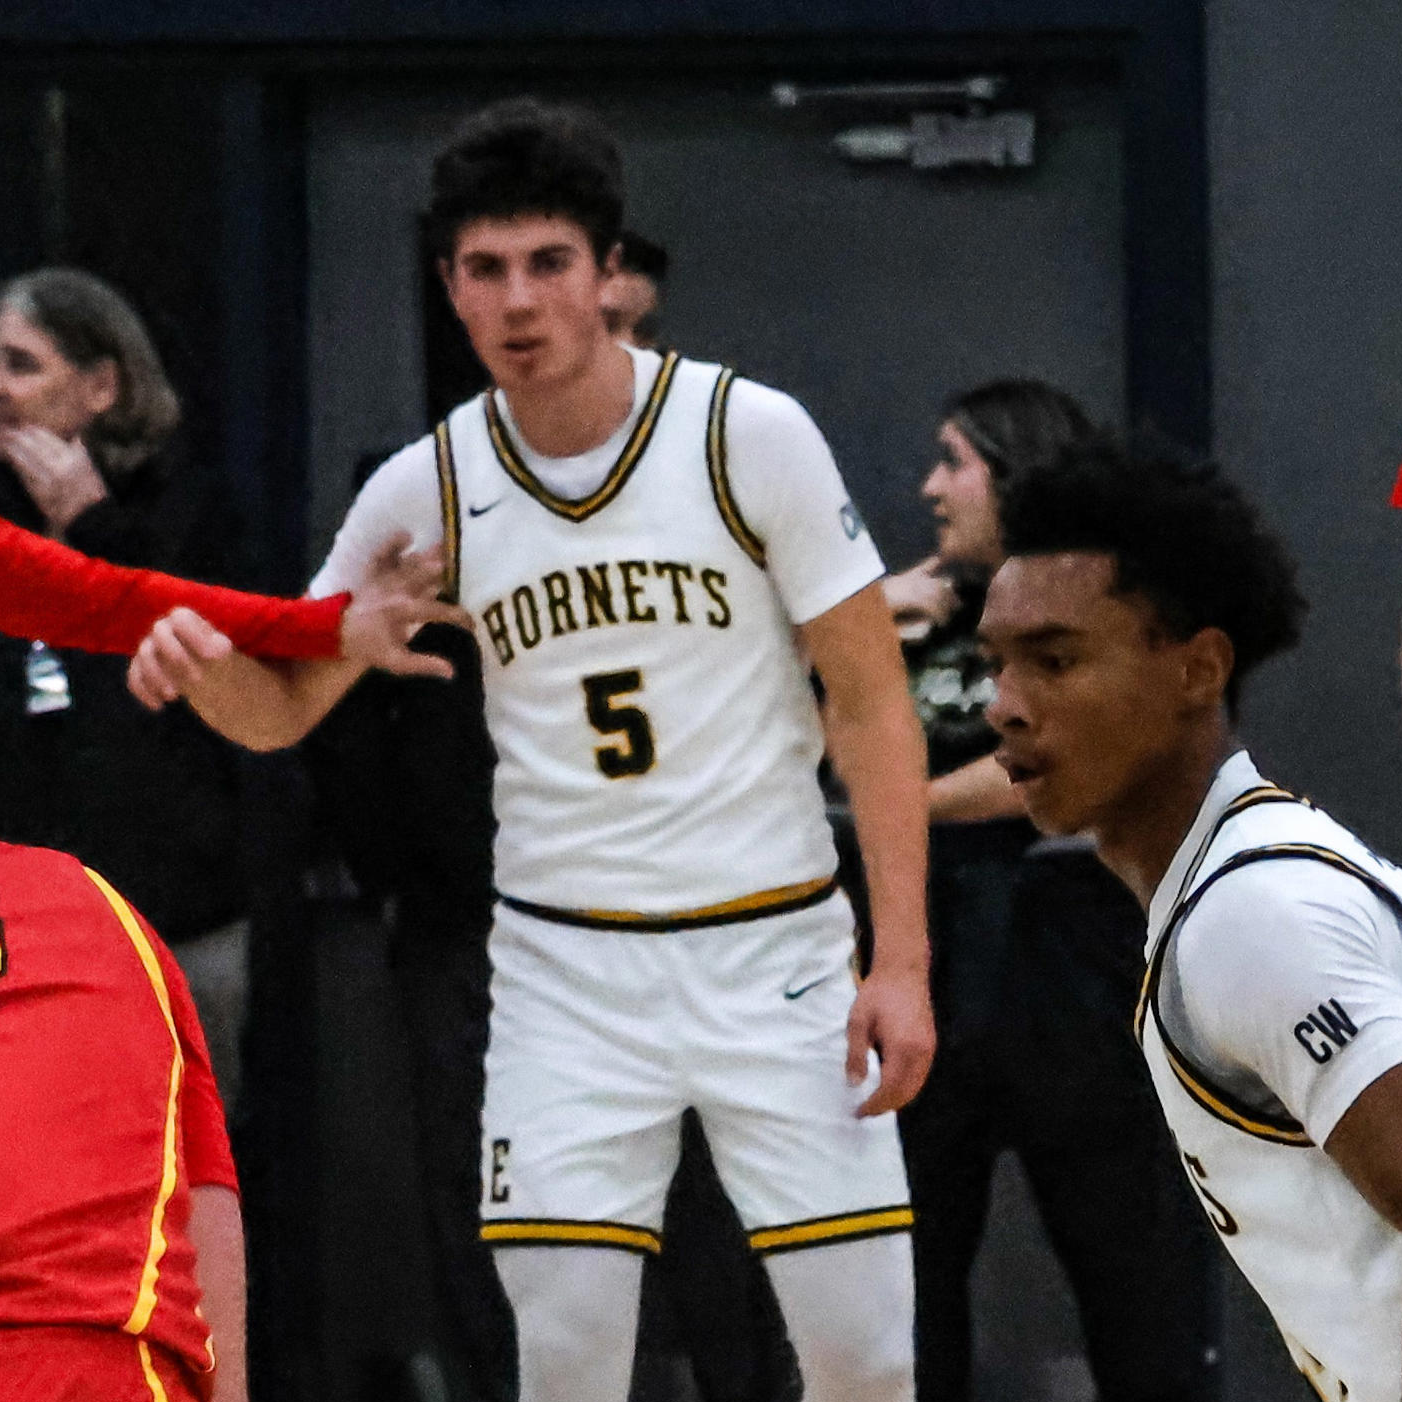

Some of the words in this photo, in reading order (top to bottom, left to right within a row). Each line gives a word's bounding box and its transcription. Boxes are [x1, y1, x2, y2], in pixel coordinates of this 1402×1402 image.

[482, 559, 732, 667] HORNETS
[581, 668, 655, 780] 5
[1294, 997, 1359, 1065] CW
